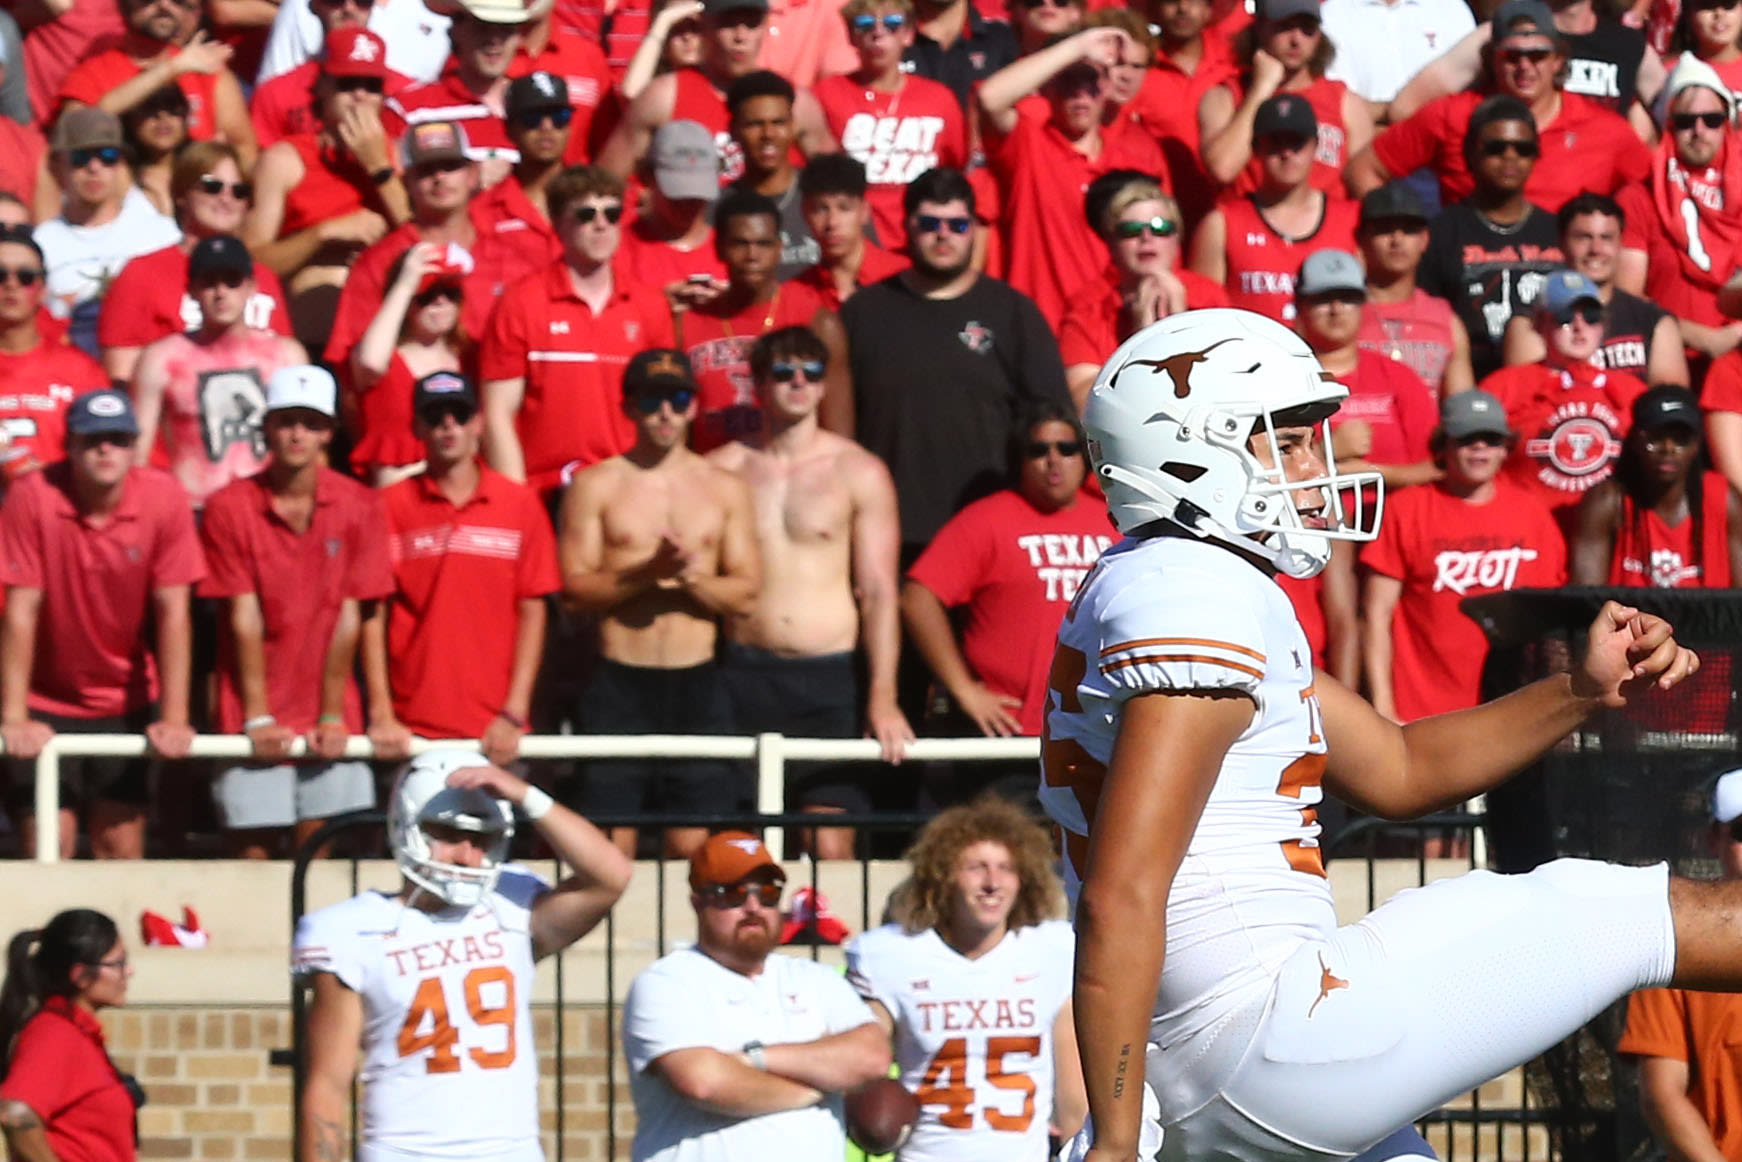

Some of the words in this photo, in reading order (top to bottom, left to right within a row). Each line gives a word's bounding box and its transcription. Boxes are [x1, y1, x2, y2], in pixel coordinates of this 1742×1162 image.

[842, 113, 944, 151] BEAT
[1240, 271, 1299, 294] TEXA
[1037, 567, 1089, 602] TE
[1433, 547, 1538, 596] RIOT
[386, 931, 504, 976] TEXAS
[396, 966, 516, 1074] 49
[916, 999, 1035, 1031] TEXAS
[915, 1035, 1041, 1132] 45
